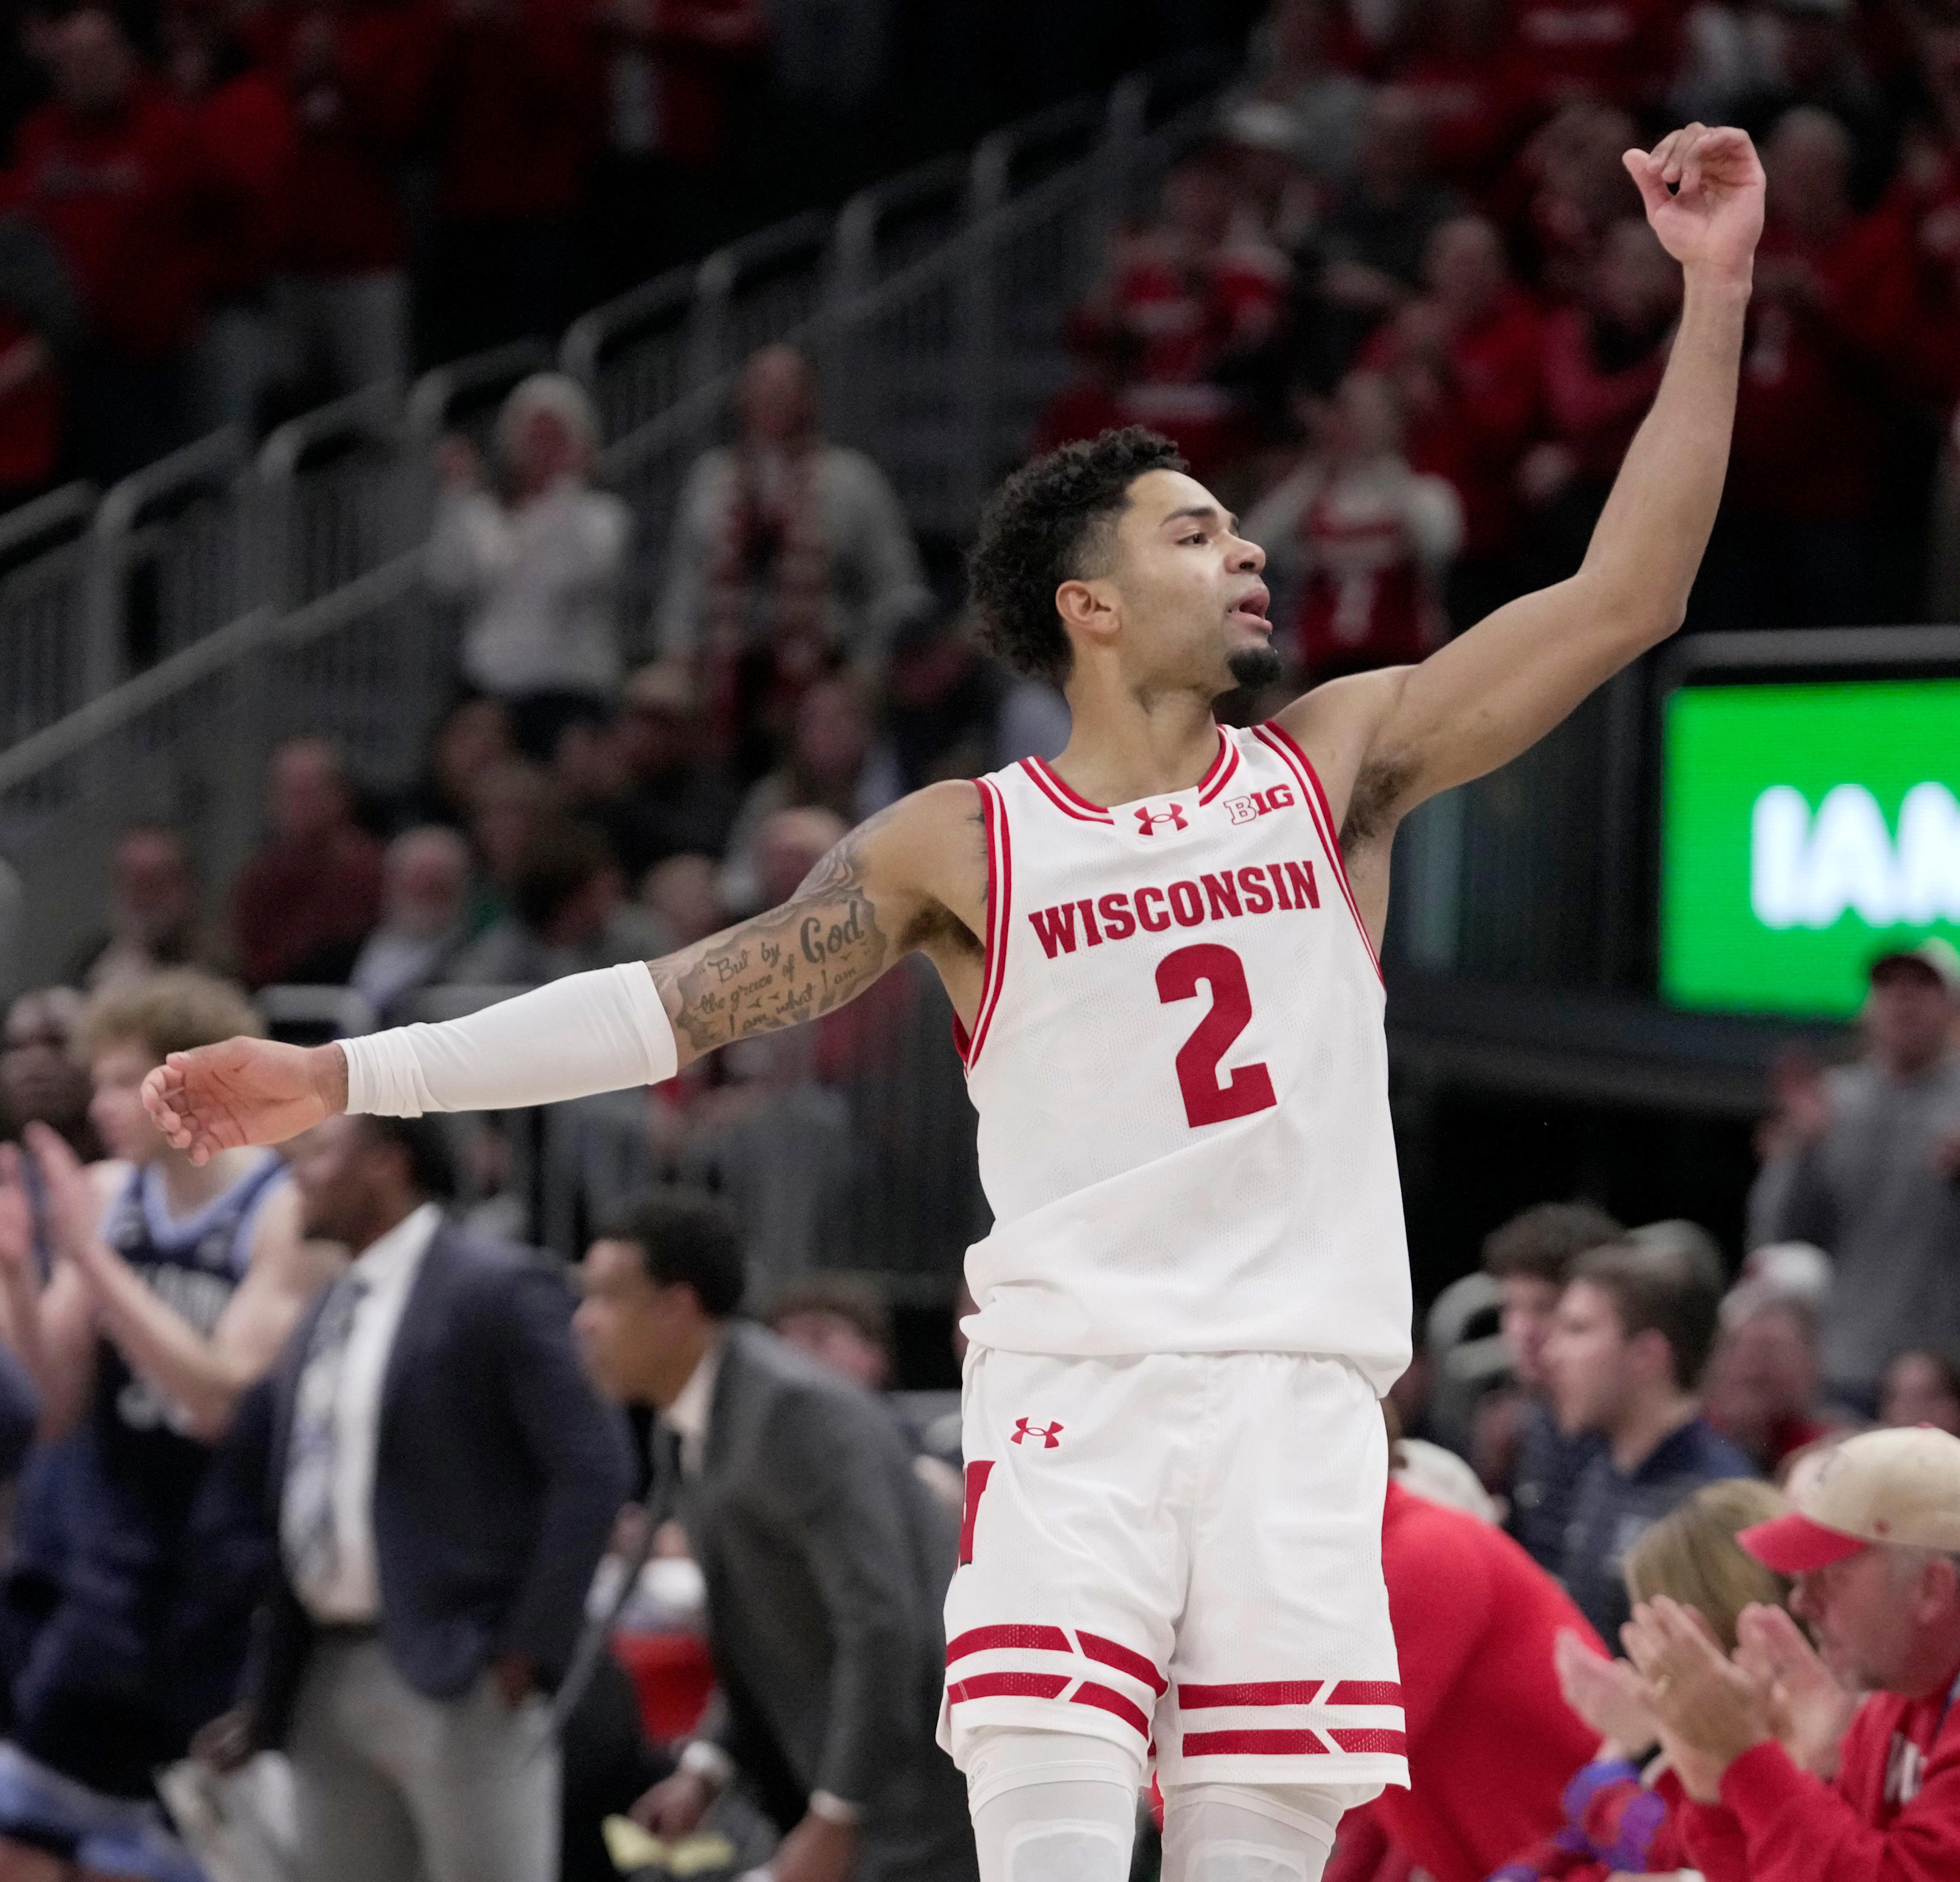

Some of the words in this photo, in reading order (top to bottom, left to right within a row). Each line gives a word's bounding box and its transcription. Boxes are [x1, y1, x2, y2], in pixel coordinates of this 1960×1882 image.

[694, 992, 725, 1015] the
[730, 974, 773, 1012] grace
[782, 953, 795, 983] of
[800, 899, 865, 964] God
[761, 942, 781, 968] by
[1028, 860, 1321, 959] WISCONSIN
[743, 1013, 768, 1031] am
[776, 983, 814, 1015] what
[834, 968, 857, 985] am
[1155, 943, 1277, 1128] 2
